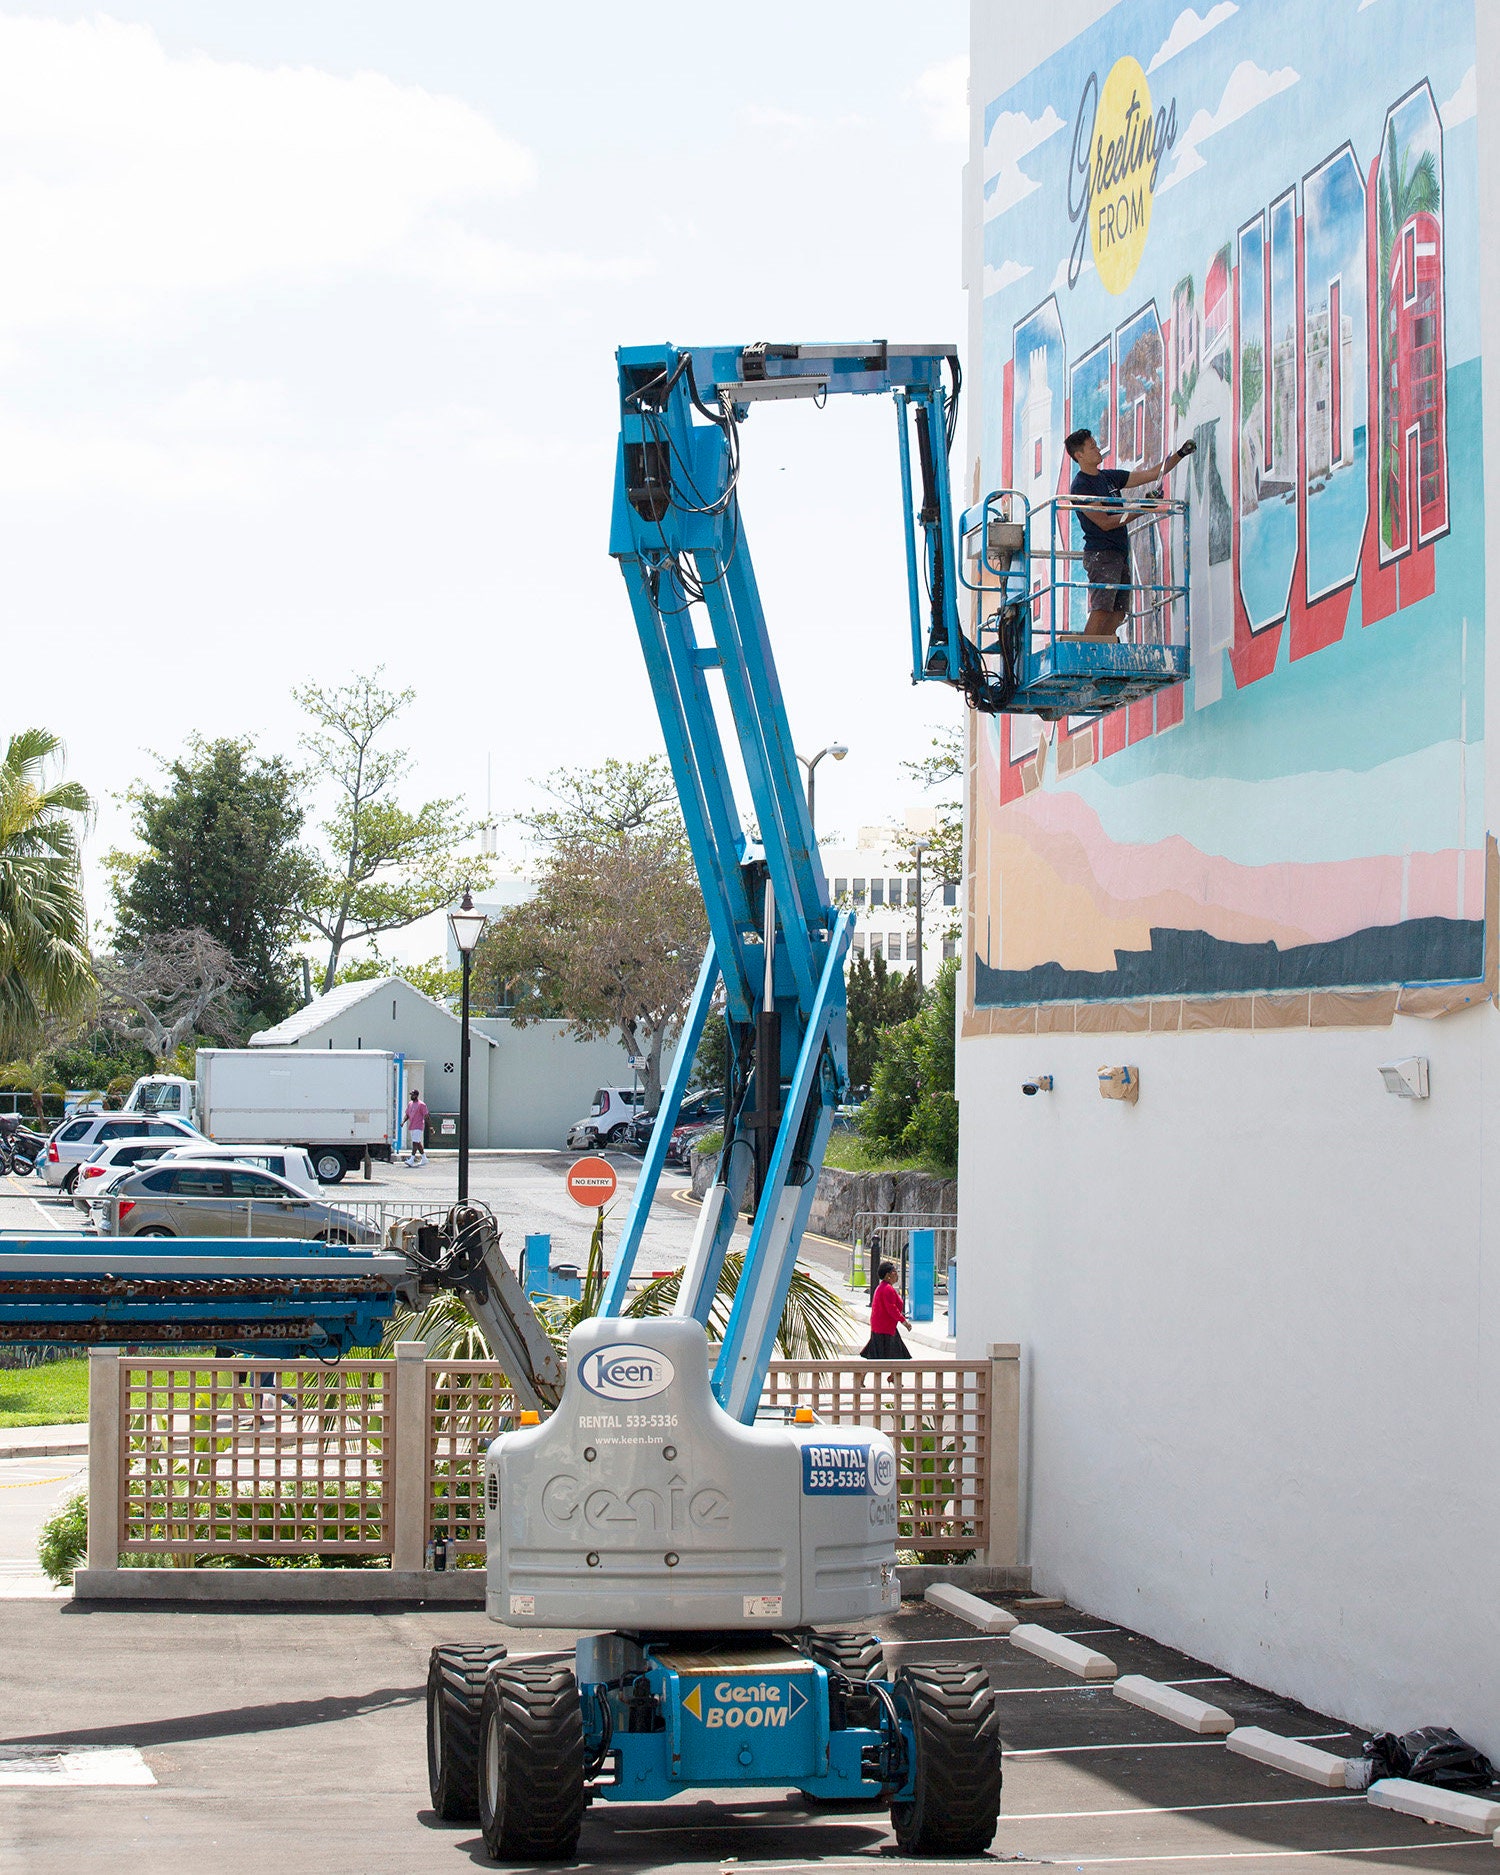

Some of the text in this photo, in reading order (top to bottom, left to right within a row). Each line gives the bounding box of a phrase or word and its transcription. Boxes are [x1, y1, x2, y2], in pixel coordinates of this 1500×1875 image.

[1068, 71, 1178, 291] Greetings
[1099, 184, 1145, 253] FROM
[595, 1354, 656, 1388] Keen
[580, 1414, 679, 1429] RENTAL 533-5336
[595, 1435, 664, 1445] www.keen.bm
[809, 1447, 866, 1469] RENTAL
[872, 1449, 893, 1486] Keen
[809, 1470, 866, 1488] 533-5336
[541, 1474, 731, 1532] Genie
[714, 1682, 781, 1703] Genie
[706, 1706, 789, 1729] BOOM
